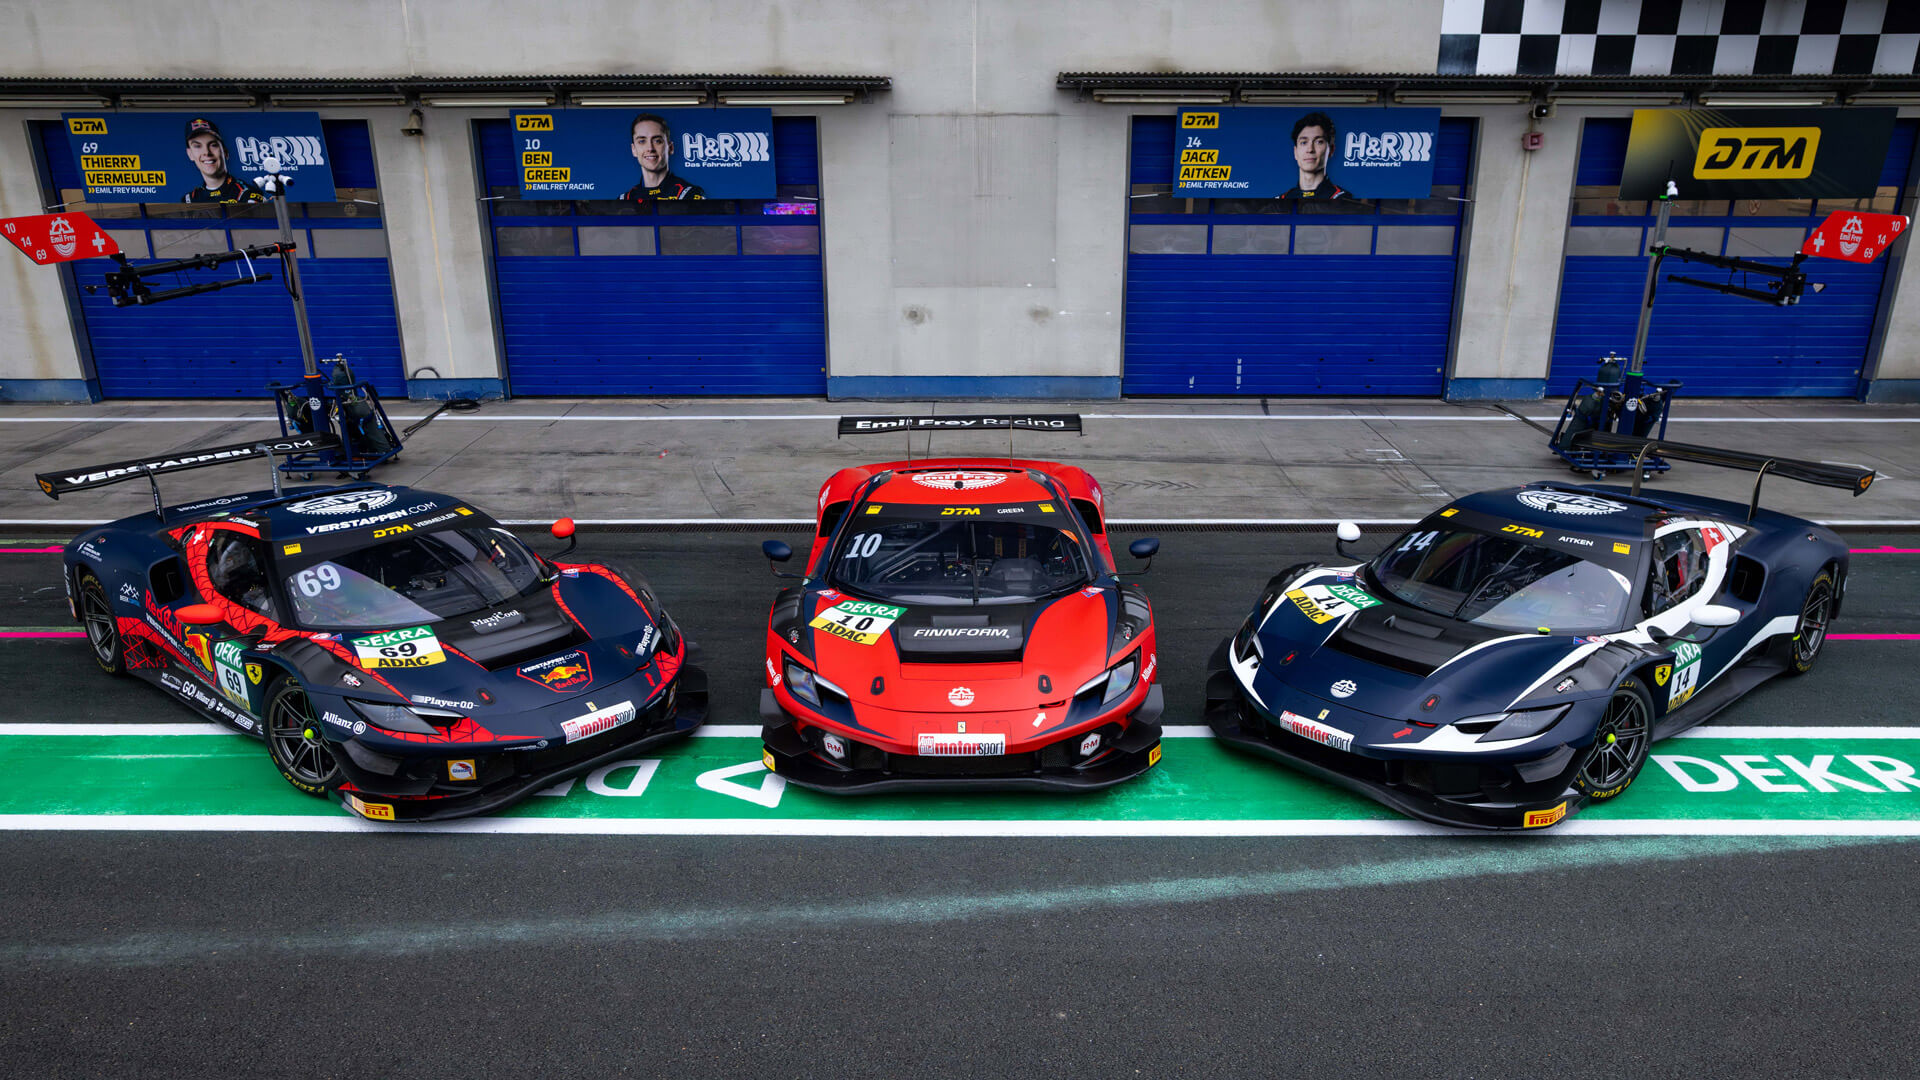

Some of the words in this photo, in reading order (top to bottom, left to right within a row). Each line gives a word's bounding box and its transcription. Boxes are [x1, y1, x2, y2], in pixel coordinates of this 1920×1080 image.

[73, 121, 105, 132] DTM
[519, 118, 551, 129] DTM
[1184, 115, 1217, 126] DTM
[82, 142, 98, 153] 69
[525, 139, 541, 150] 10
[682, 132, 742, 162] H&R
[1185, 136, 1202, 148] 14
[1344, 132, 1402, 163] H&R
[236, 136, 297, 166] H&R
[1182, 151, 1216, 163] JACK
[1702, 137, 1808, 170] DTM
[82, 157, 137, 168] THIERRY
[524, 154, 550, 165] BEN
[87, 173, 165, 184] VERMEULEN
[526, 169, 569, 181] GREEN
[1181, 168, 1229, 180] AITKEN
[1186, 181, 1203, 189] EMIL
[1203, 181, 1222, 189] FREY
[1222, 181, 1249, 189] RACING
[4, 222, 16, 234] 10
[1891, 221, 1901, 232] 10
[21, 236, 32, 248] 14
[1877, 234, 1887, 245] 14
[36, 249, 47, 260] 69
[1863, 248, 1874, 258] 69
[856, 420, 912, 430] Emil
[919, 418, 977, 428] Frey
[983, 418, 1065, 429] Racing
[305, 502, 438, 535] VERSTAPPEN.COM
[941, 507, 981, 516] DTM
[413, 513, 458, 528] VERMEULEN
[373, 524, 414, 539] DTM
[1500, 524, 1545, 539] DTM
[845, 532, 882, 559] 10
[1397, 530, 1439, 552] 14
[1558, 535, 1594, 547] AITKEN
[298, 564, 342, 598] 69
[1313, 595, 1345, 610] 14
[1329, 585, 1376, 608] DEKRA
[837, 601, 899, 618] DEKRA
[1293, 596, 1326, 620] ADAC
[836, 615, 874, 631] 10
[353, 627, 432, 648] DEKRA
[821, 621, 867, 643] ADAC
[380, 642, 418, 658] 69
[1672, 643, 1701, 668] EKRA
[377, 655, 430, 668] ADAC
[225, 669, 242, 695] 69
[554, 680, 572, 689] Red
[1673, 667, 1691, 694] 14
[423, 696, 460, 708] Player
[322, 711, 353, 730] Allianz
[1650, 755, 1920, 793] DEKR
[1528, 806, 1565, 825] PIRELLI
